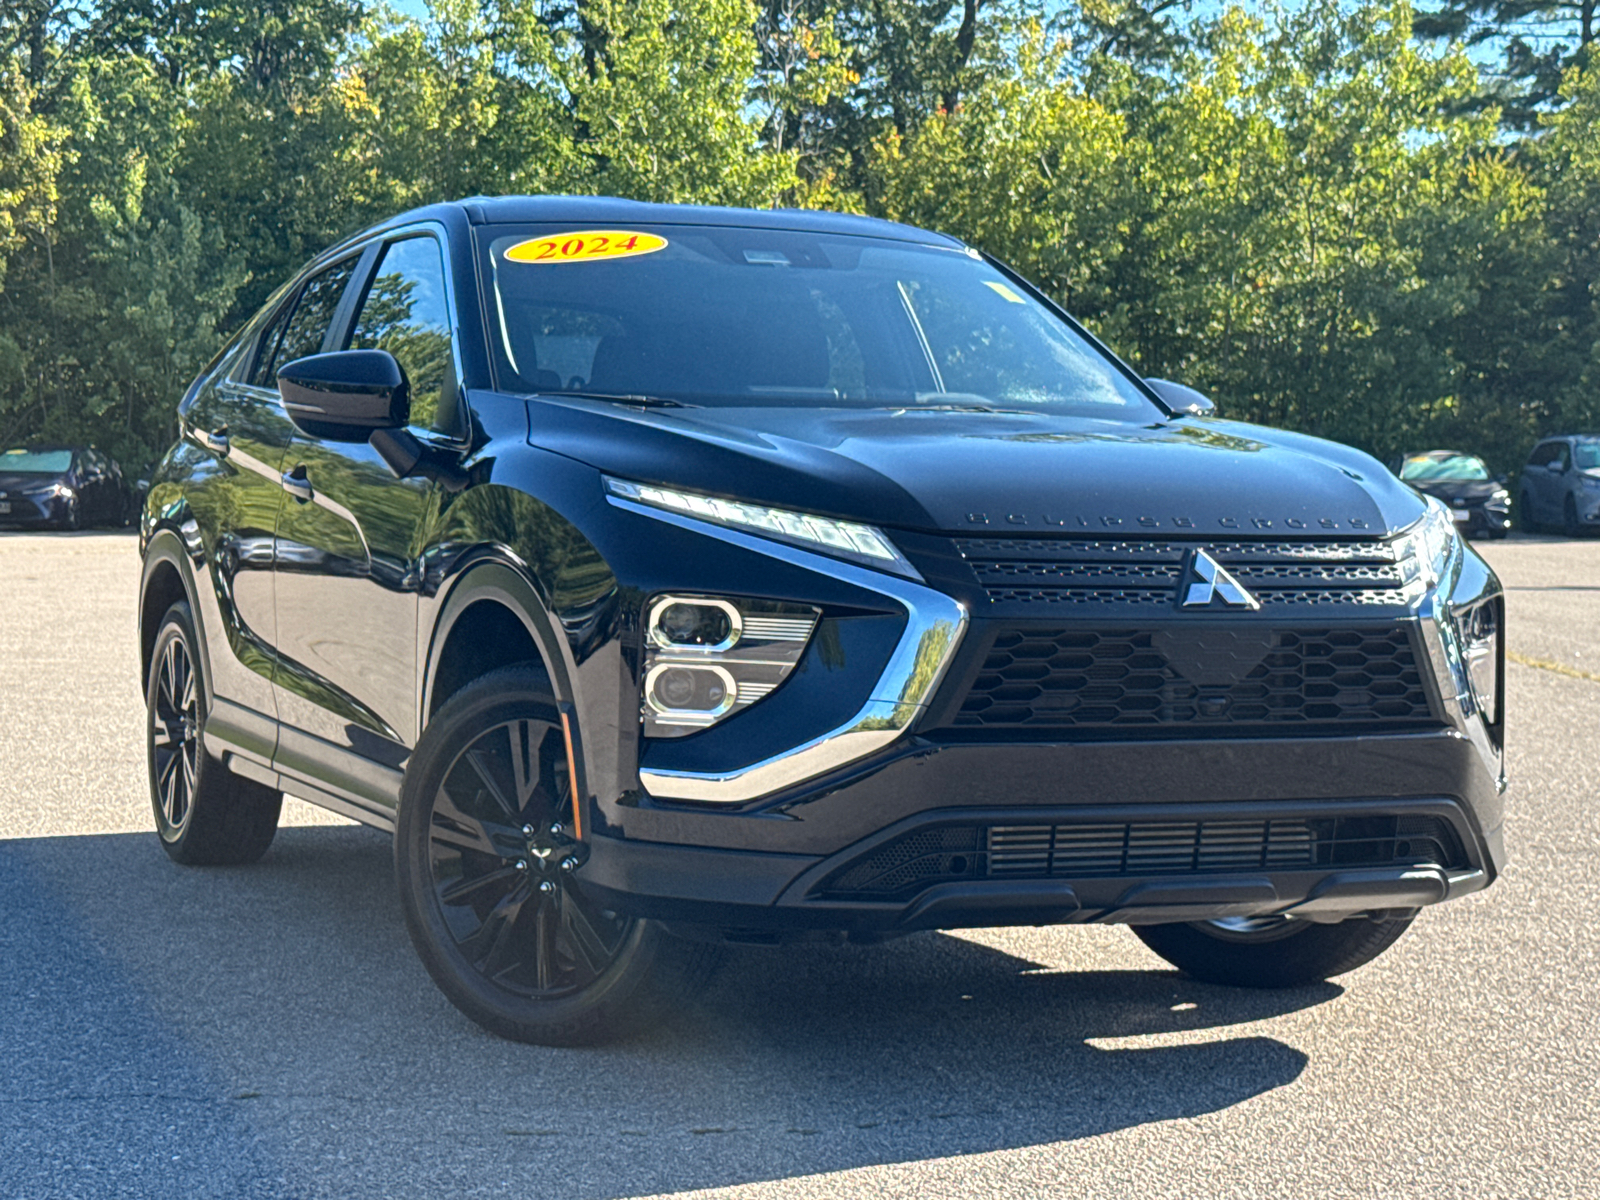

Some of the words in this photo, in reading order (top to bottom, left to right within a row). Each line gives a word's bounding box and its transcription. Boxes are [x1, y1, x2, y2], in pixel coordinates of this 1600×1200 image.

[535, 235, 638, 260] 2024
[964, 512, 1196, 528] ECLIPSE
[1218, 517, 1370, 529] CROSS
